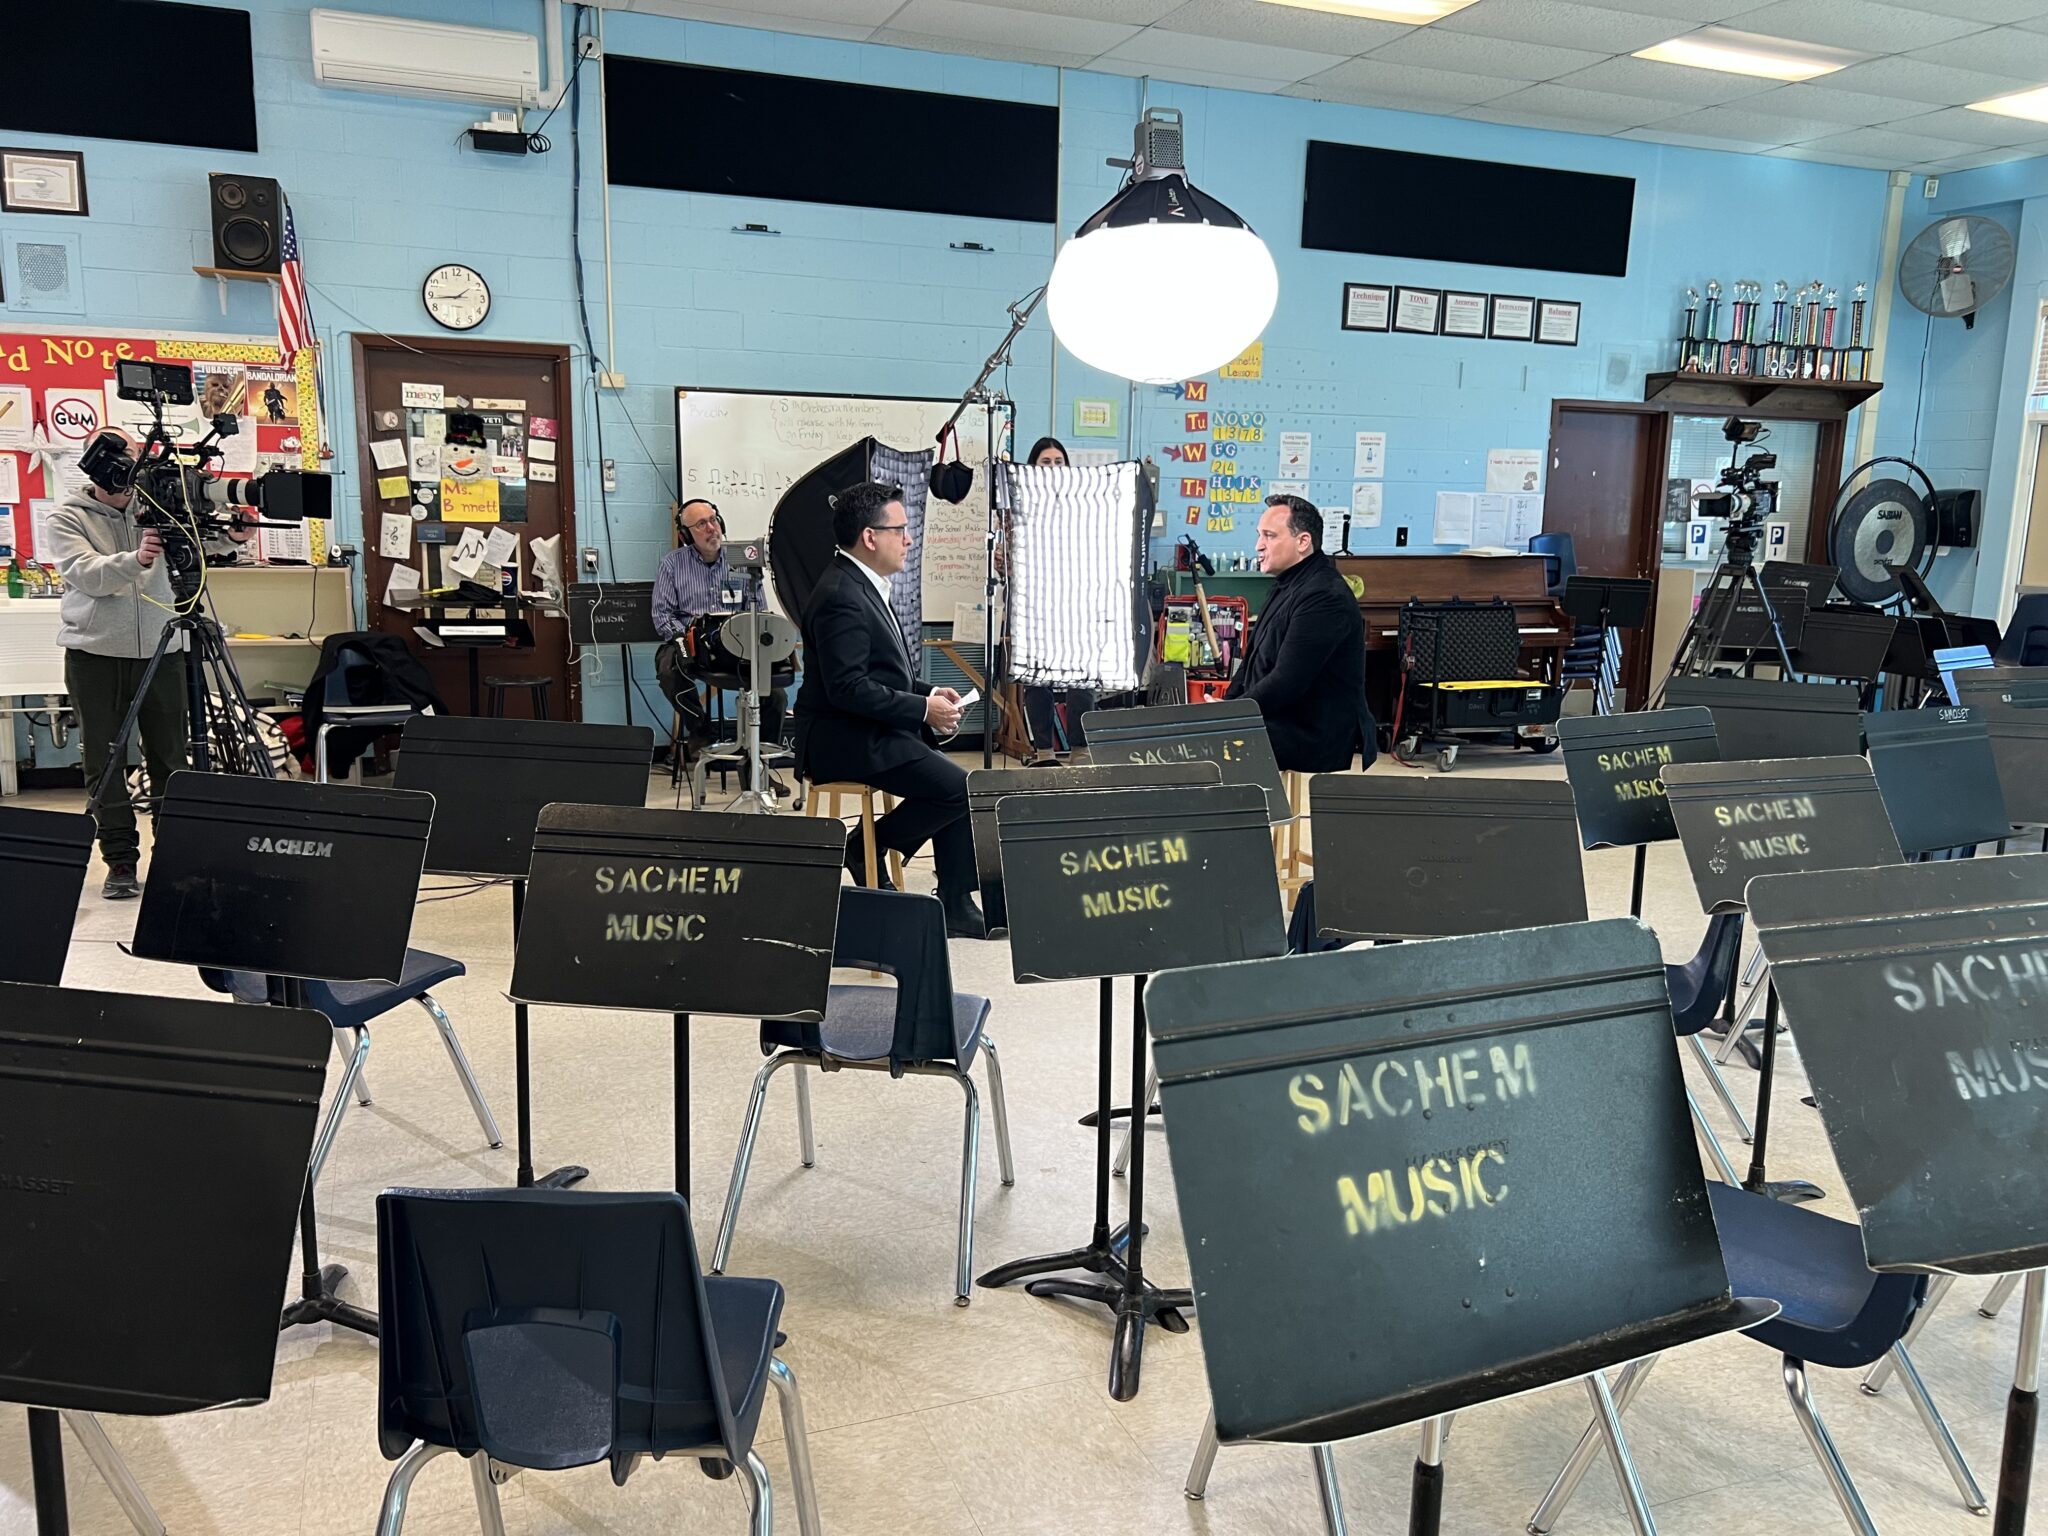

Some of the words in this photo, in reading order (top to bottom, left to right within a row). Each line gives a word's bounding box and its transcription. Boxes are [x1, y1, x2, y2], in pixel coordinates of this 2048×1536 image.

[452, 268, 462, 277] 12
[405, 390, 441, 402] merry
[55, 412, 94, 426] GUM
[483, 416, 502, 424] YETI
[1184, 444, 1204, 461] W
[444, 482, 472, 496] Ms.
[1597, 744, 1673, 772] SACHEM
[1614, 778, 1667, 801] MUSIC
[1714, 796, 1817, 827] SACHEM
[246, 836, 333, 858] SACHEM
[1060, 837, 1188, 876] SACHEM
[1738, 832, 1811, 860] MUSIC
[595, 866, 743, 894] SACHEM
[1082, 883, 1172, 918] MUSIC
[605, 913, 707, 942] MUSIC
[1289, 1042, 1537, 1134] SACHEM
[1336, 1149, 1509, 1236] MUSIC
